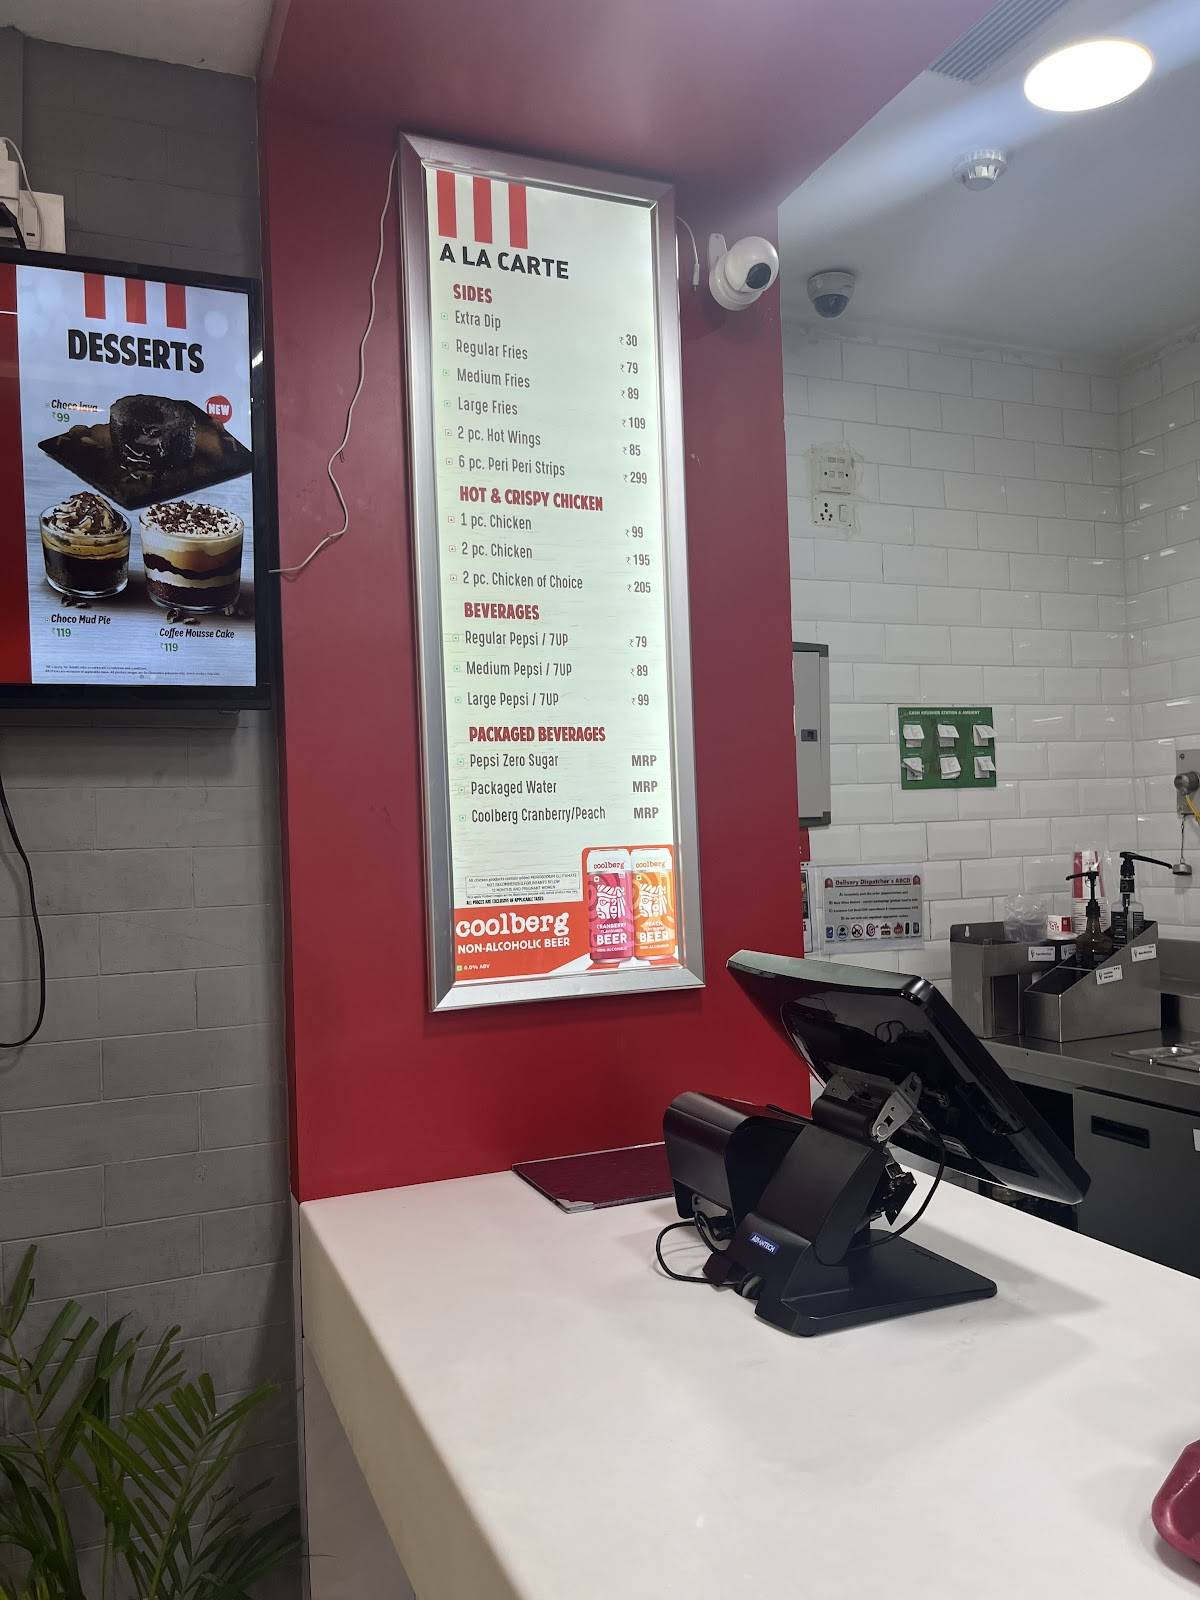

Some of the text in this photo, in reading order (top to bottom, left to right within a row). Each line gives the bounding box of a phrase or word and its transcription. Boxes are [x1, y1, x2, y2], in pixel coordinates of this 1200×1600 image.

[440, 244, 568, 279] A LA CARTE
[453, 284, 492, 303] SIDES
[456, 311, 501, 331] Extra Dip
[67, 329, 205, 373] DESSERTS
[456, 339, 528, 360] Regular Fries
[457, 368, 530, 388] Medium Fries
[206, 404, 230, 416] NEW
[458, 397, 518, 415] Large Fries
[458, 426, 541, 448] 2 pc. Hot Wings
[458, 455, 565, 478] 6 pc. Peri Peri Strips
[460, 486, 603, 511] HOT & CRISPY CHICKEN
[460, 513, 531, 530] 1 pc. Chicken
[462, 542, 532, 559] 2 pc. Chicken
[463, 571, 583, 589] 2 pc. Chicken of Choice
[51, 614, 111, 624] Choco Mud Pie
[464, 602, 539, 620] BEVERAGES
[159, 628, 234, 638] Coffee Mousse Cake
[465, 631, 568, 648] Regular Pepsi / 7UP
[466, 662, 571, 678] Medium Pepsi / 7UP
[467, 692, 558, 708] Large Pepsi / 7UP
[469, 727, 606, 742] PACKAGED BEVERAGES
[470, 754, 558, 770] Pepsi Zero Sugar
[632, 755, 657, 767] MRP
[471, 781, 557, 797] Packaged Water
[632, 781, 658, 792] MRP
[472, 807, 606, 824] Coolberg Cranberry/Peach
[633, 807, 659, 819] MRP
[594, 862, 624, 870] coolberg
[456, 912, 569, 937] coolberg
[597, 933, 627, 945] BEER
[640, 931, 669, 942] BEER
[458, 938, 570, 954] NON-ALCOHOLIC BEER
